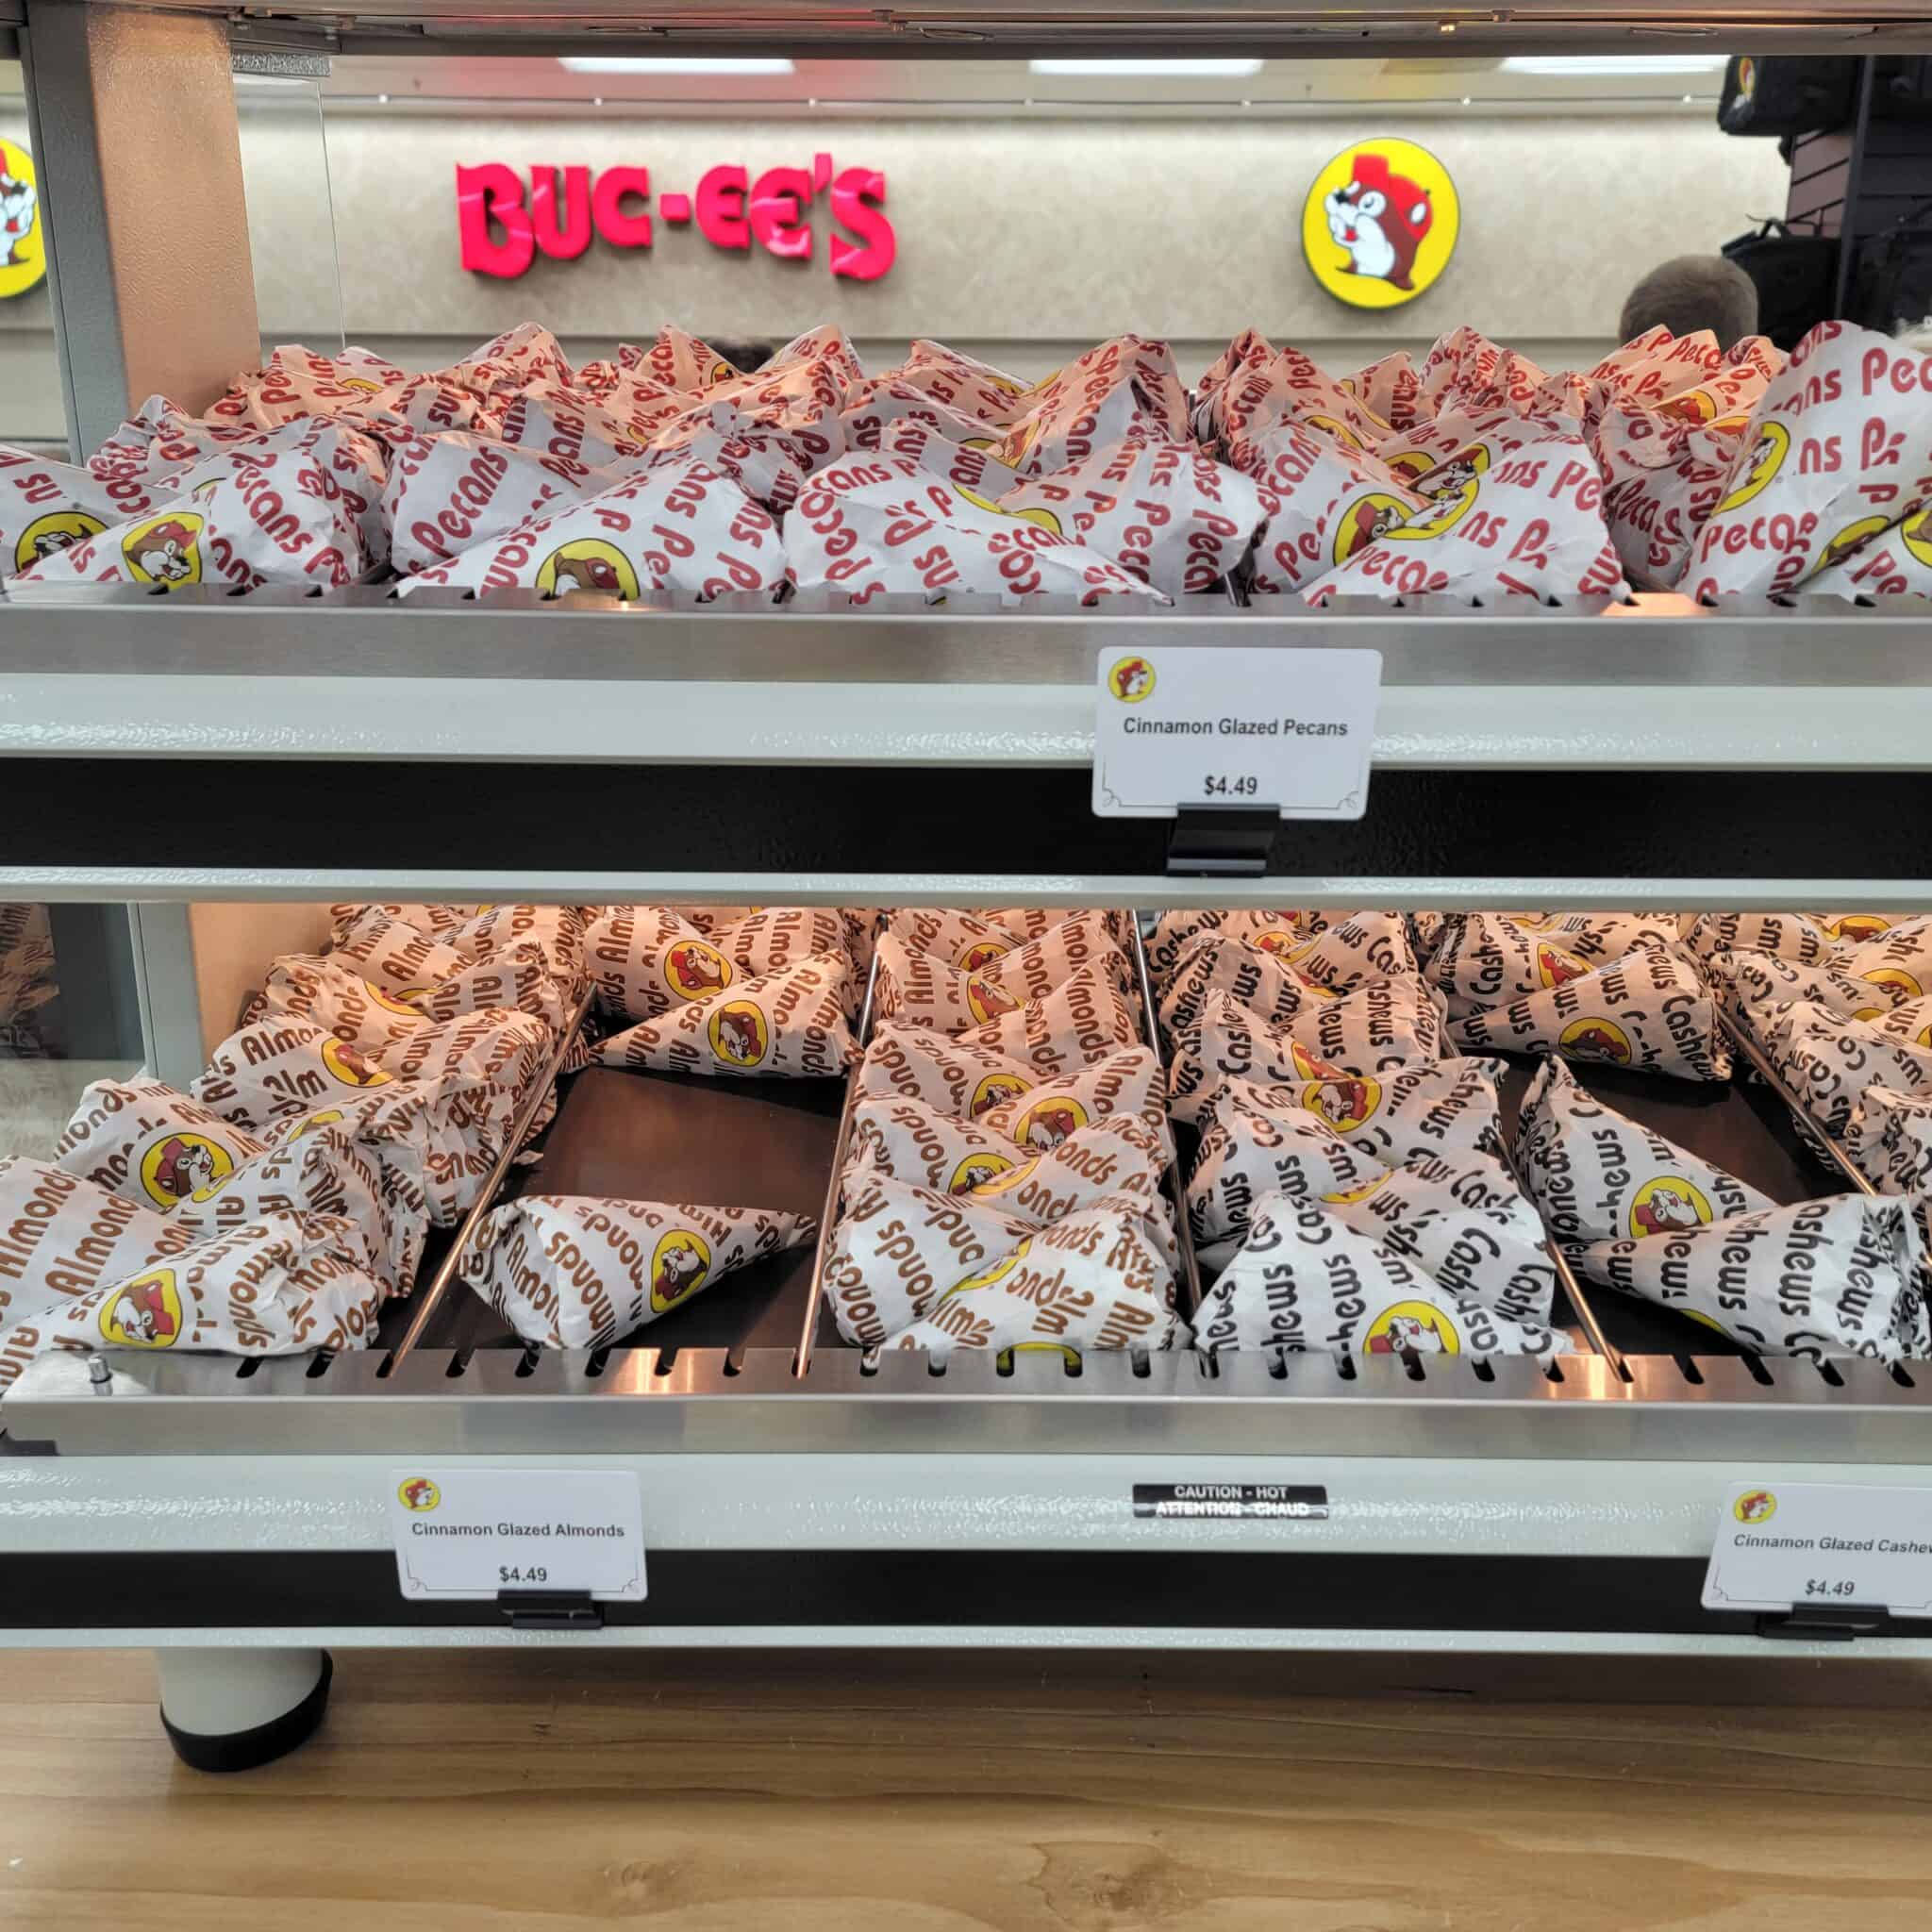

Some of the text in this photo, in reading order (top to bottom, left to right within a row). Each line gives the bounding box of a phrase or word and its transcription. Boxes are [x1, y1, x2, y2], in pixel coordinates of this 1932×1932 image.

[456, 152, 896, 280] BUC-EE'S
[227, 452, 313, 554] Pecans
[411, 445, 508, 558] Pecans
[1184, 509, 1239, 589] Peca
[1124, 717, 1348, 737] Cinnamon Glazed Pecans
[1205, 775, 1257, 795] $4.49
[774, 969, 822, 1025] Almo
[1171, 951, 1219, 1029] ashews
[241, 1027, 320, 1066] Almo
[1093, 1055, 1142, 1114] Almo
[1420, 1073, 1485, 1140] shews
[1056, 1141, 1117, 1185] onds
[45, 1191, 140, 1296] Almond
[1436, 1227, 1500, 1294] Cash
[1778, 1205, 1834, 1316] ashews
[1261, 1264, 1306, 1348] hews
[1494, 1264, 1555, 1322] Cash
[1174, 1486, 1242, 1499] CAUTION
[1256, 1486, 1288, 1499] HOT
[412, 1523, 625, 1538] Cinnamon Glazed Almonds
[1734, 1534, 1814, 1550] Cinnamon
[1819, 1537, 1874, 1552] Glazed
[499, 1566, 547, 1583] $4.49
[1806, 1579, 1856, 1596] $4.49
